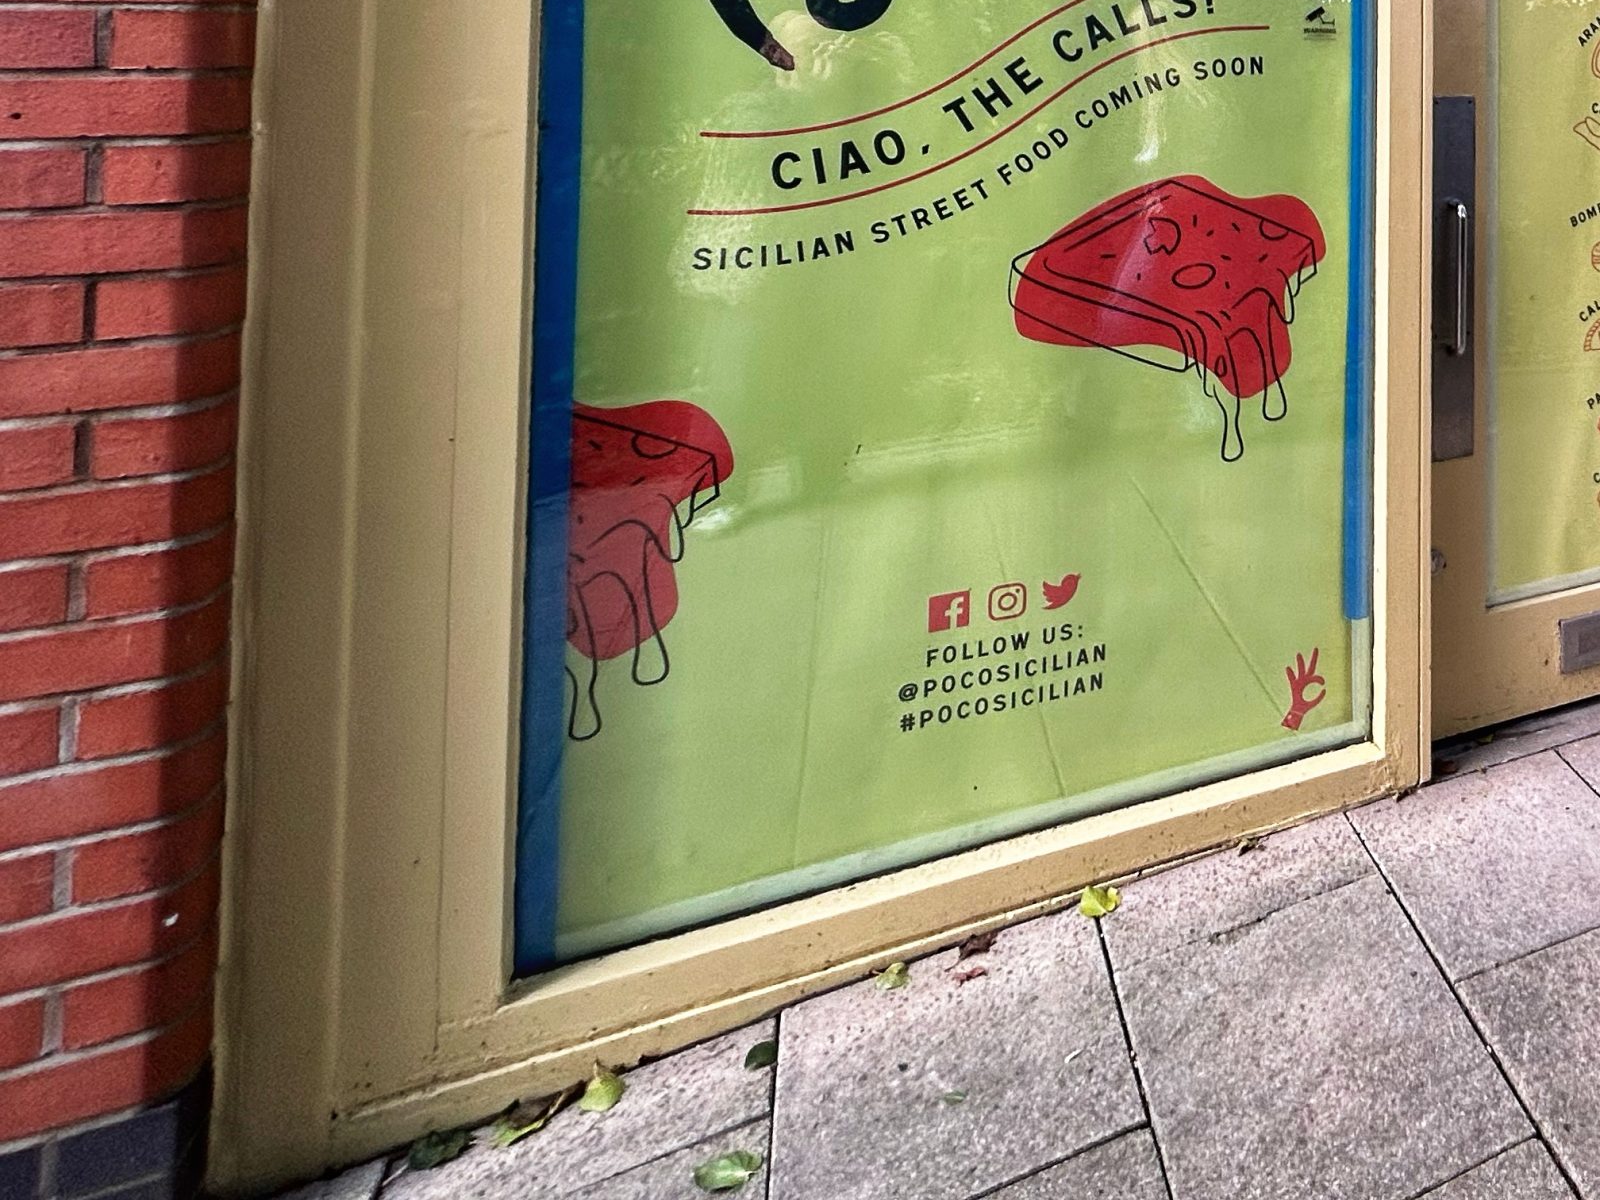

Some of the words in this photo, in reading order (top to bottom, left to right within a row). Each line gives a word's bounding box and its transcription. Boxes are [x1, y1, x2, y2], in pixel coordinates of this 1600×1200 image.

[771, 129, 931, 190] CIAO,
[943, 56, 1044, 133] THE
[692, 230, 855, 271] SICILIAN
[871, 179, 991, 244] STREET
[996, 129, 1070, 186] FOOD
[1074, 66, 1182, 130] COMING
[1193, 55, 1266, 80] SOON
[898, 643, 1106, 701] @POCOSICILIAN
[926, 631, 1030, 667] FOLLOW
[1042, 623, 1083, 645] US:
[900, 672, 1103, 732] #POCOSICILIAN
